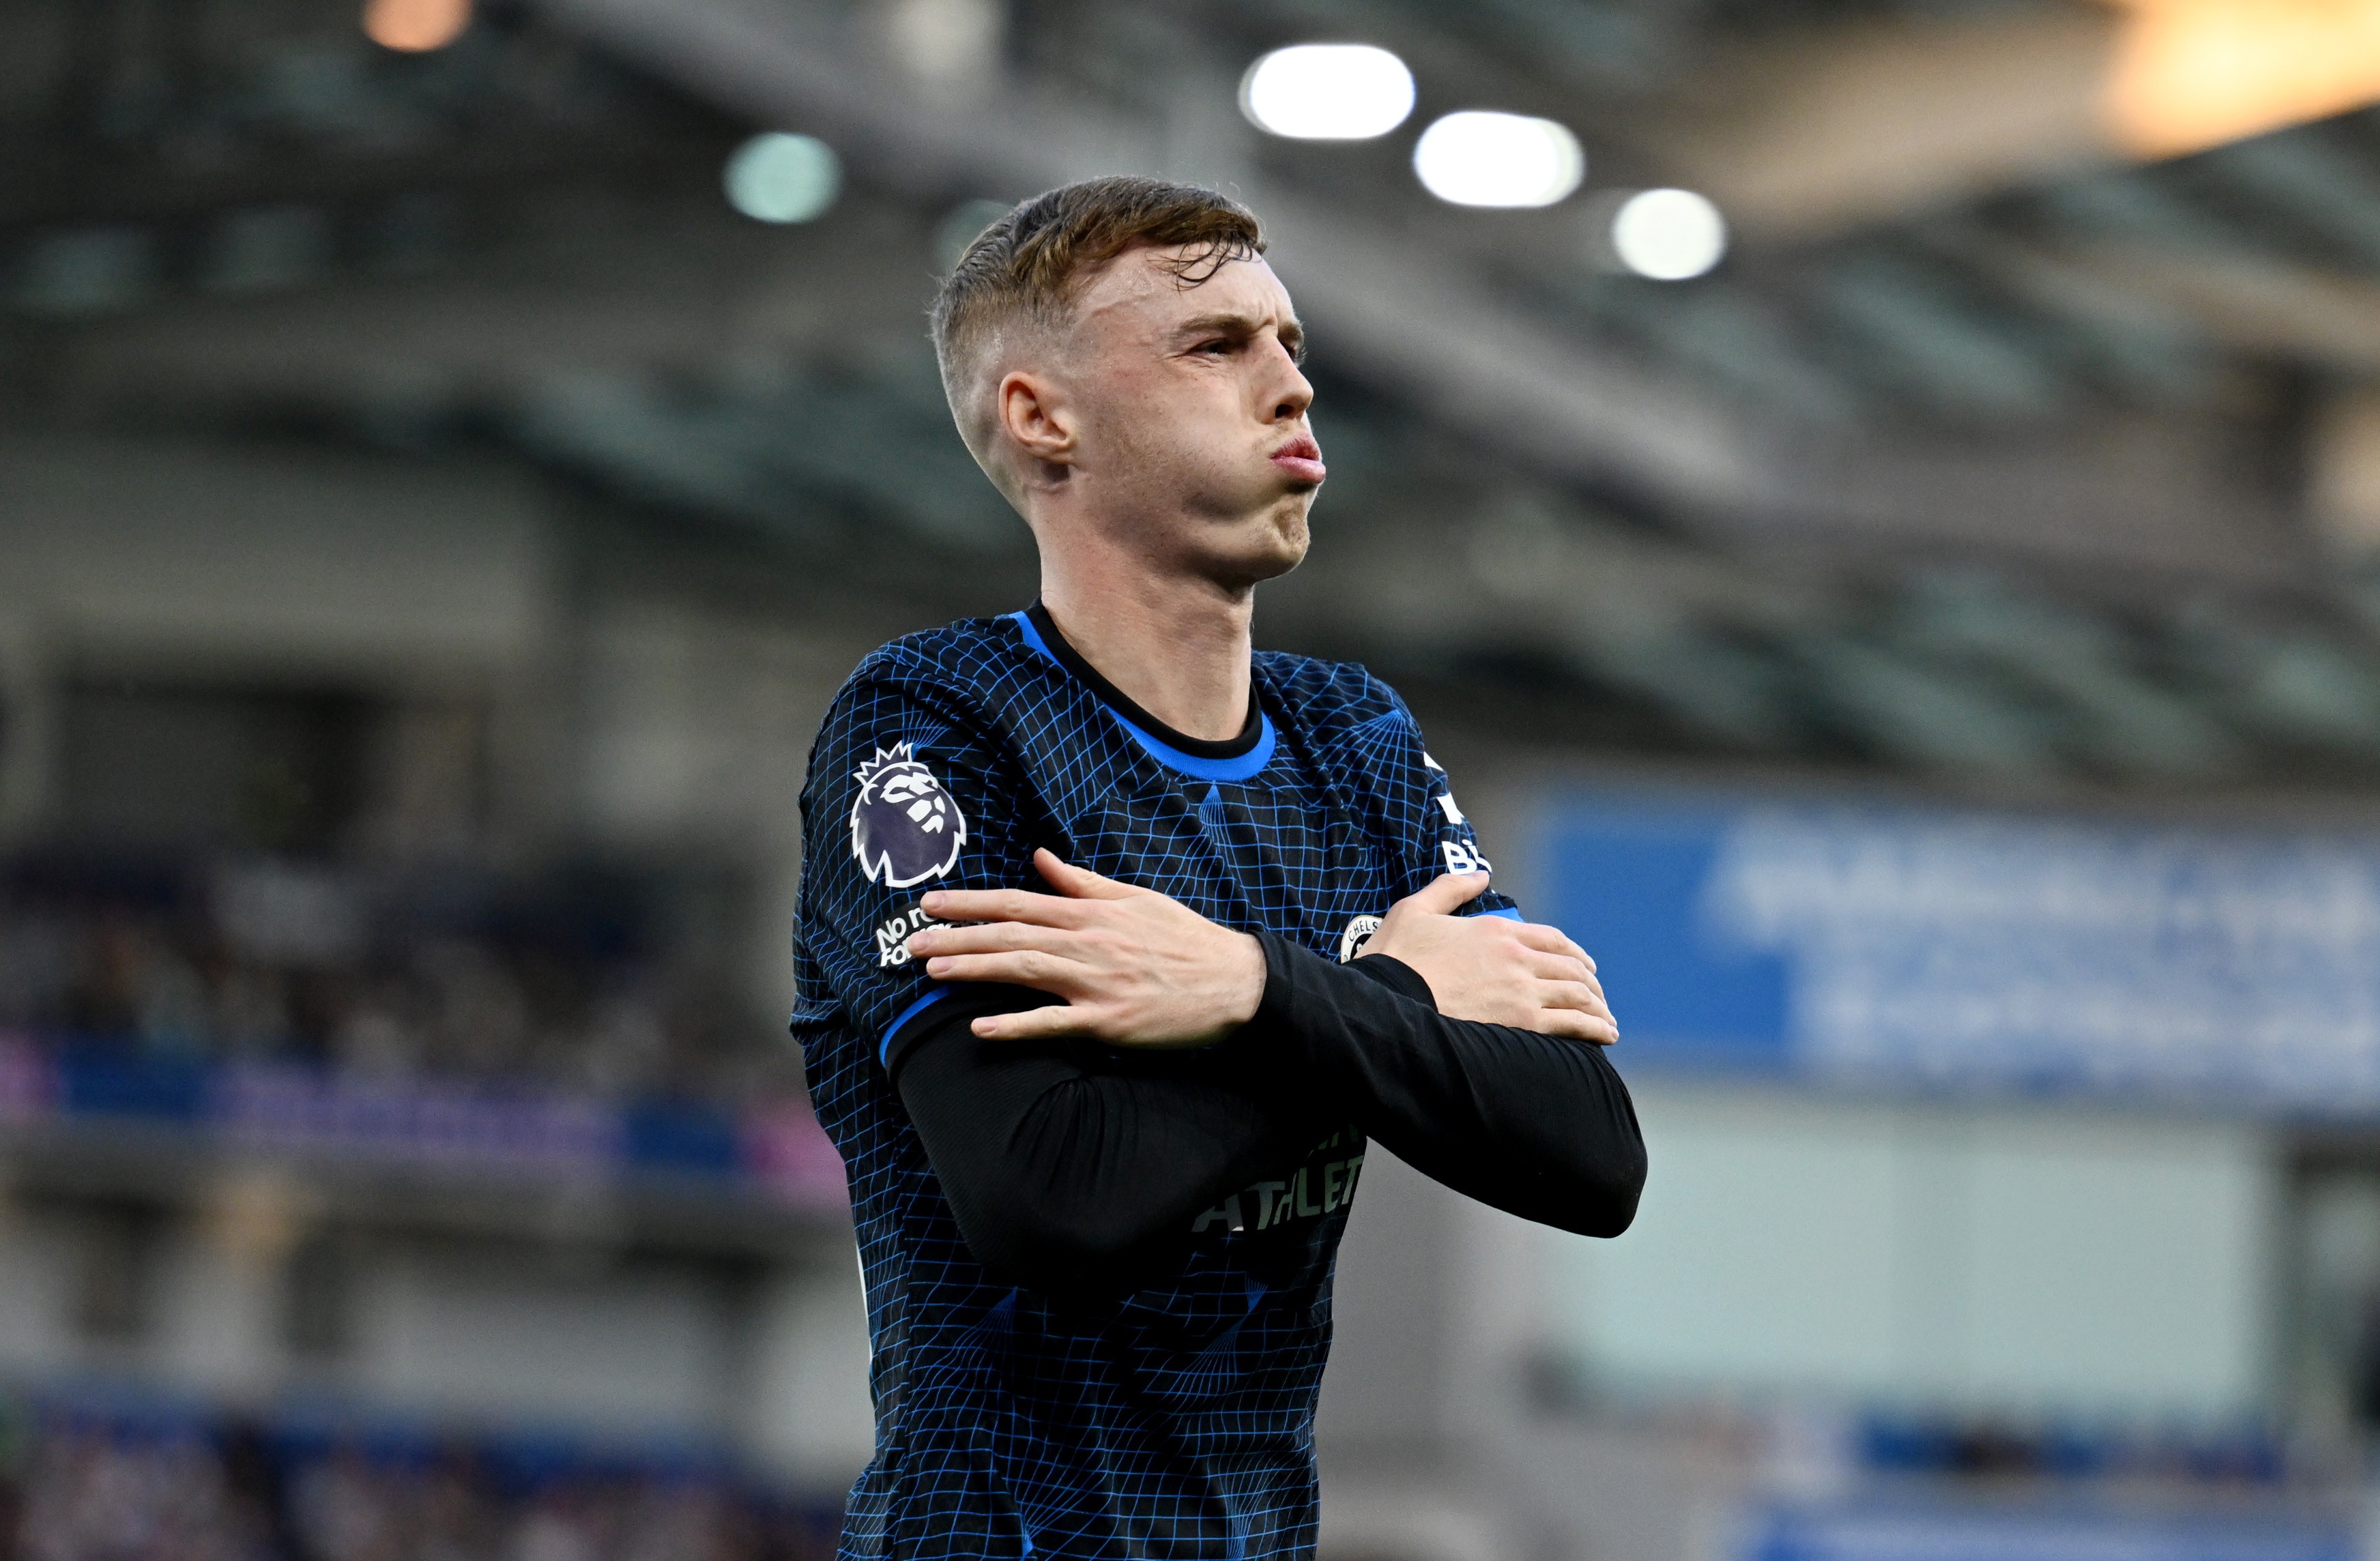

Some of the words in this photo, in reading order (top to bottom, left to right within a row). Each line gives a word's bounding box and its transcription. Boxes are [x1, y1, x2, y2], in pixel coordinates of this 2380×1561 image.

[876, 917, 907, 952] No
[1348, 920, 1378, 942] CHELS
[1191, 1154, 1365, 1232] ATHLET
